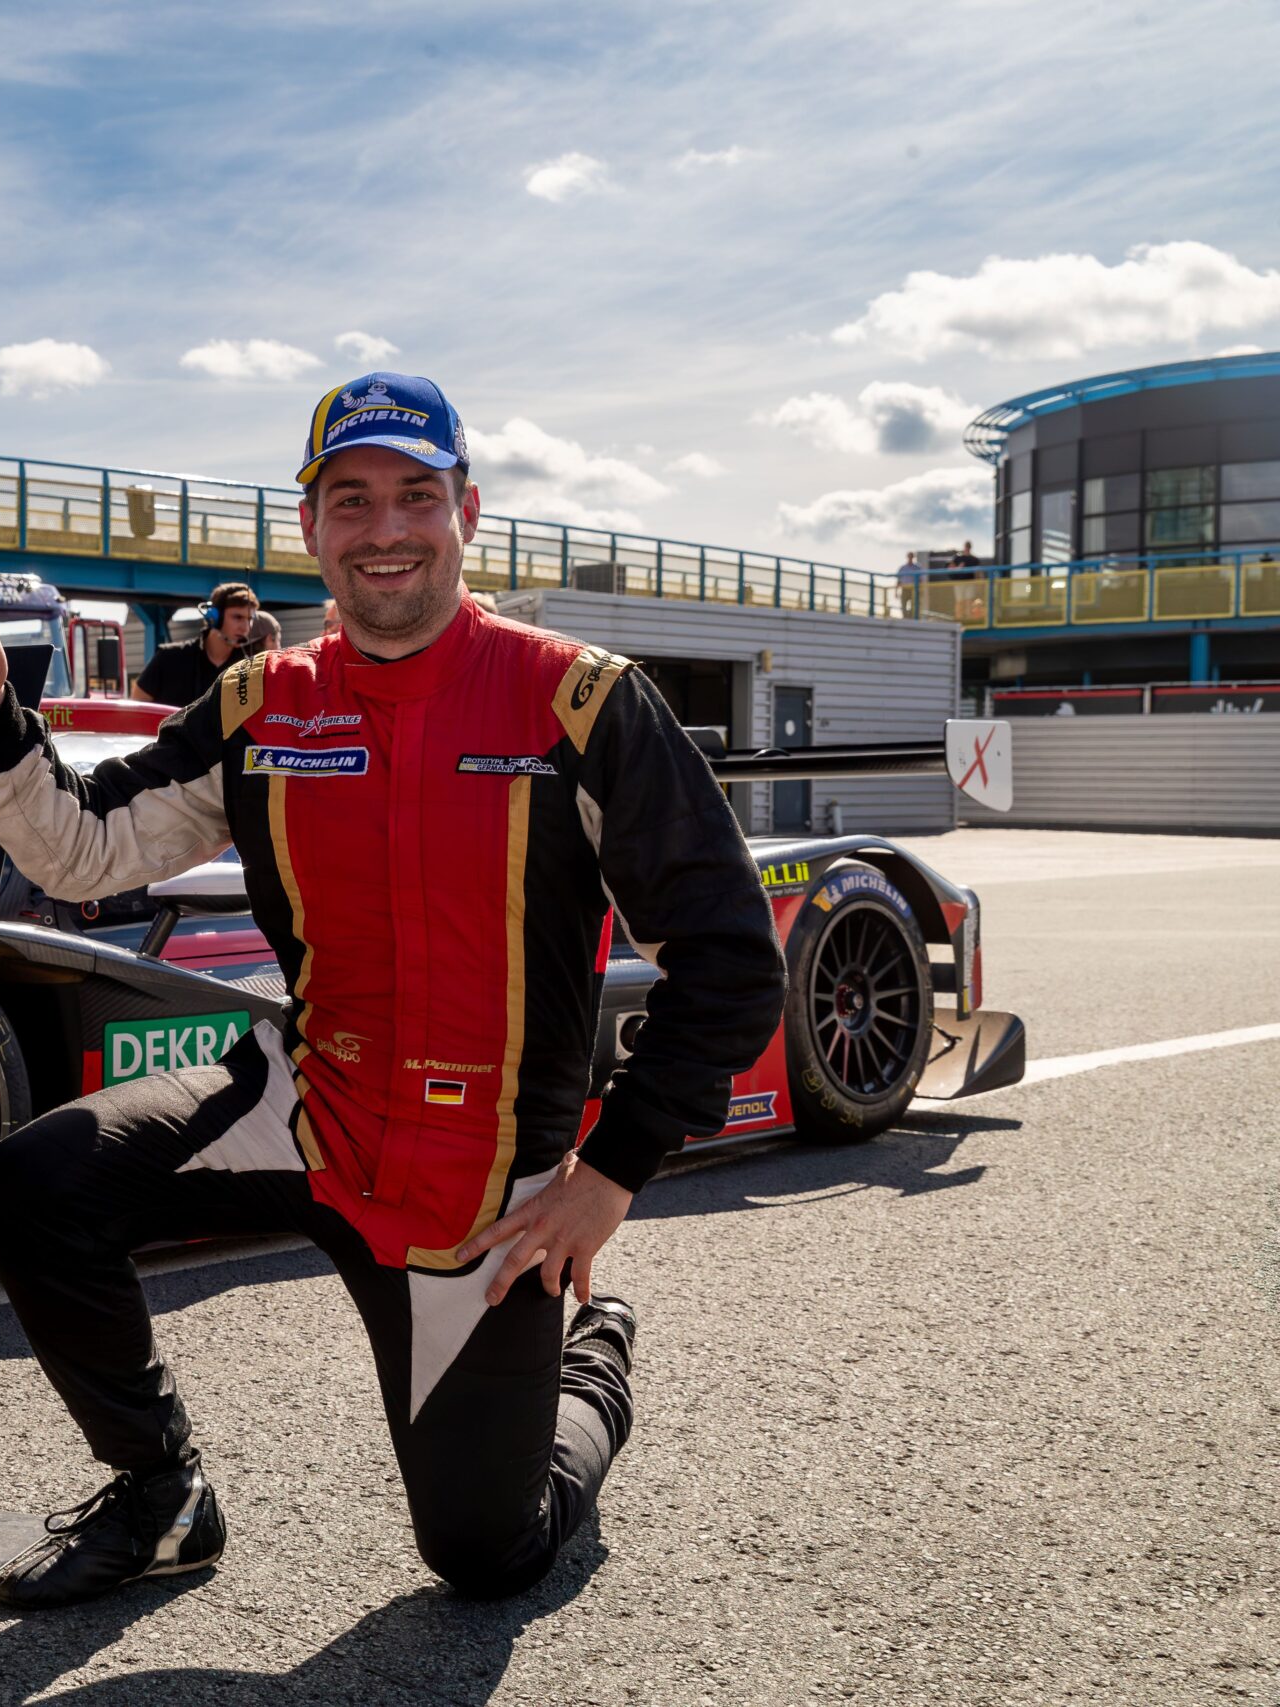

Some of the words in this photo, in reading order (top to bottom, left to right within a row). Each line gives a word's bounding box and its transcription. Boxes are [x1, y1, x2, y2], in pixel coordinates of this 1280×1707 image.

[325, 409, 427, 446] MICHELIN
[264, 714, 304, 729] RACING
[301, 710, 362, 735] EXPERIENCE
[278, 755, 358, 769] MICHELIN
[462, 757, 504, 765] PROTOTYPE
[476, 764, 515, 772] GERMANY
[840, 874, 909, 912] MICHELIN
[112, 1021, 240, 1078] DEKRA
[316, 1037, 362, 1063] galuppo
[402, 1058, 422, 1070] M.
[422, 1059, 496, 1073] Pommer
